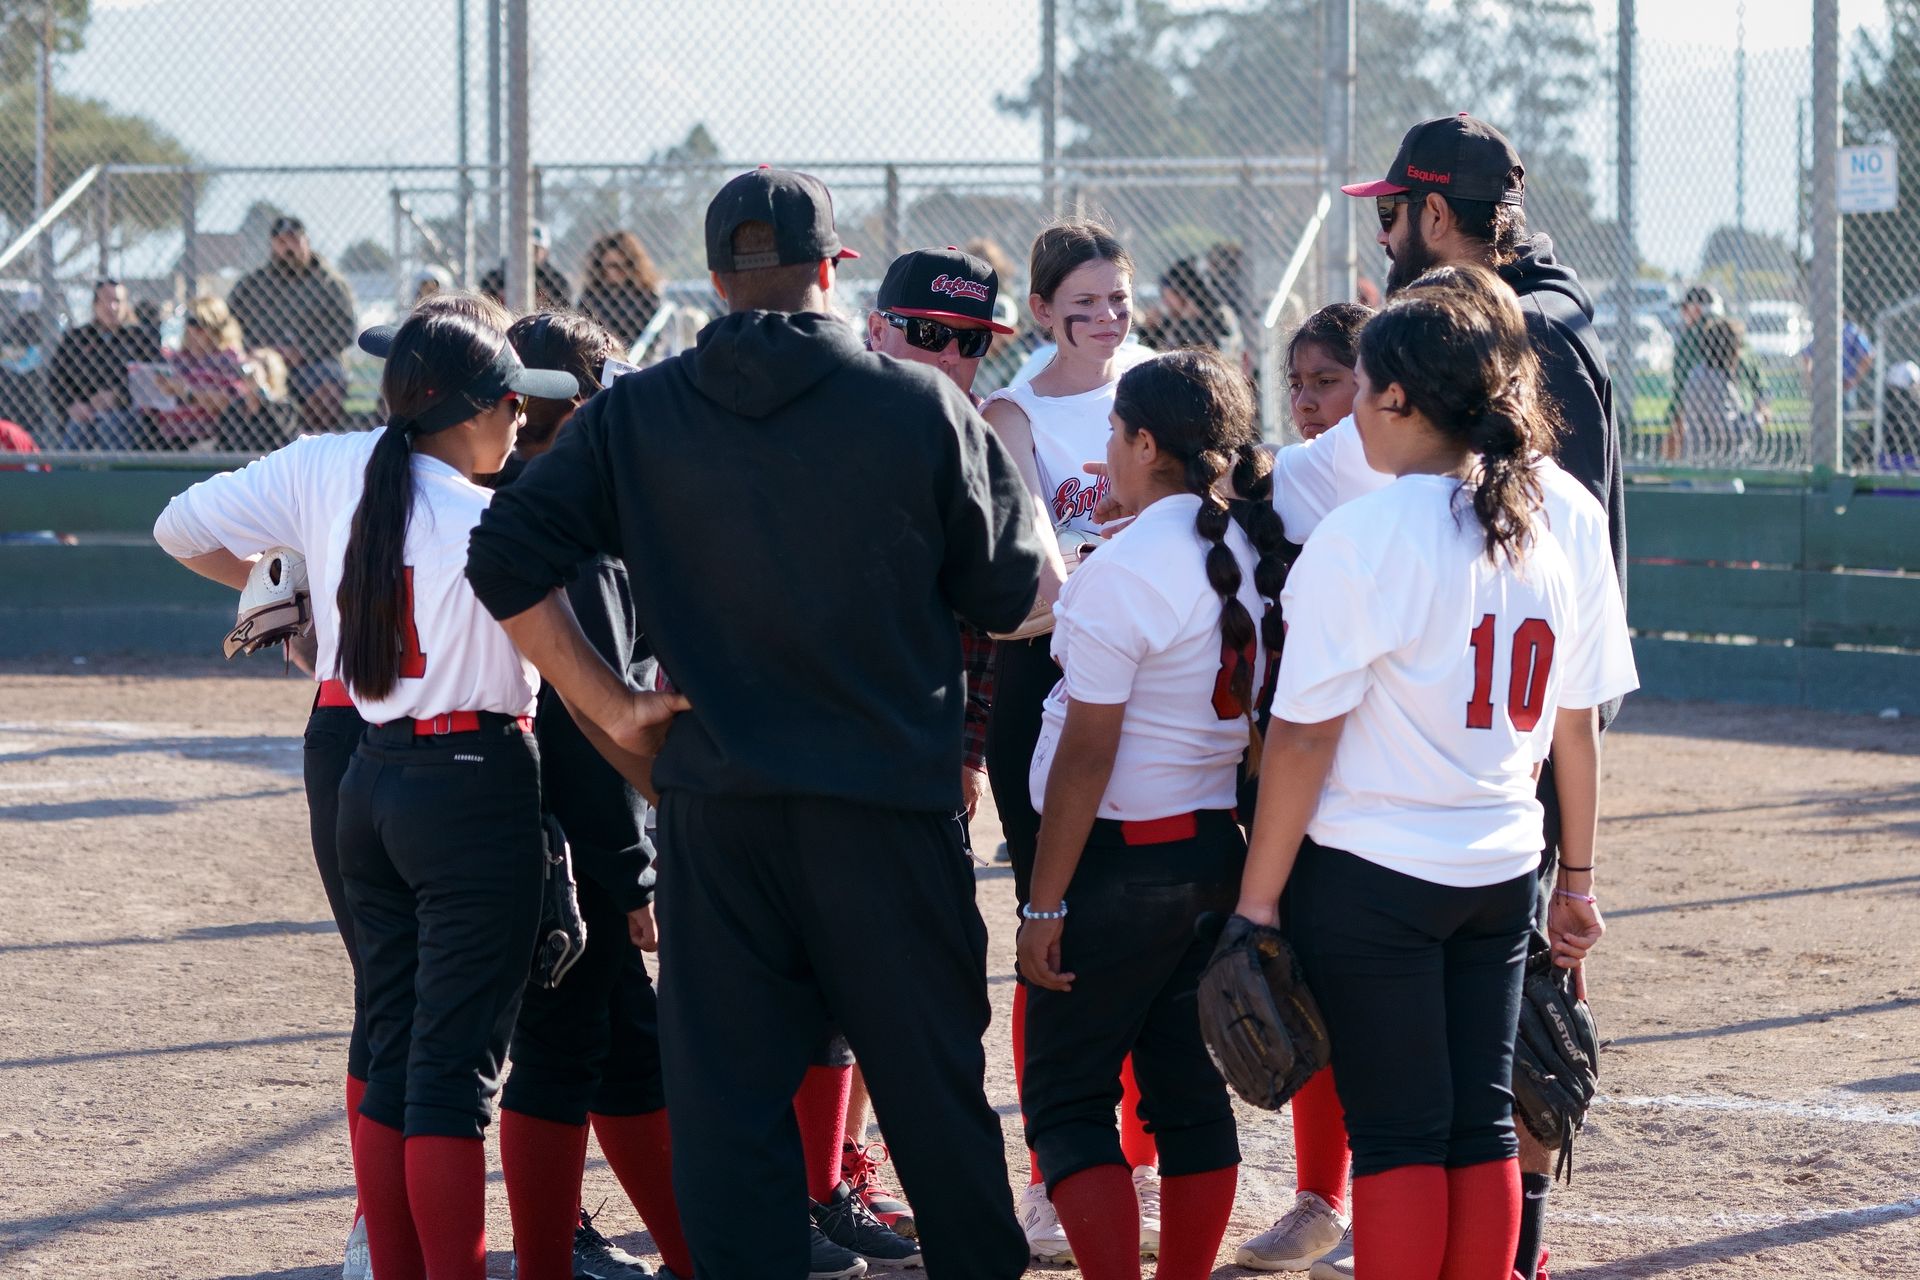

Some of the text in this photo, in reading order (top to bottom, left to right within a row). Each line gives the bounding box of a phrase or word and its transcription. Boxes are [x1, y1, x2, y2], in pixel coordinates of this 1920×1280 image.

[1407, 164, 1450, 184] Esquivel
[1851, 151, 1883, 174] NO
[1052, 477, 1111, 525] Enf
[1465, 613, 1556, 732] 10
[1546, 1002, 1585, 1061] EASTON
